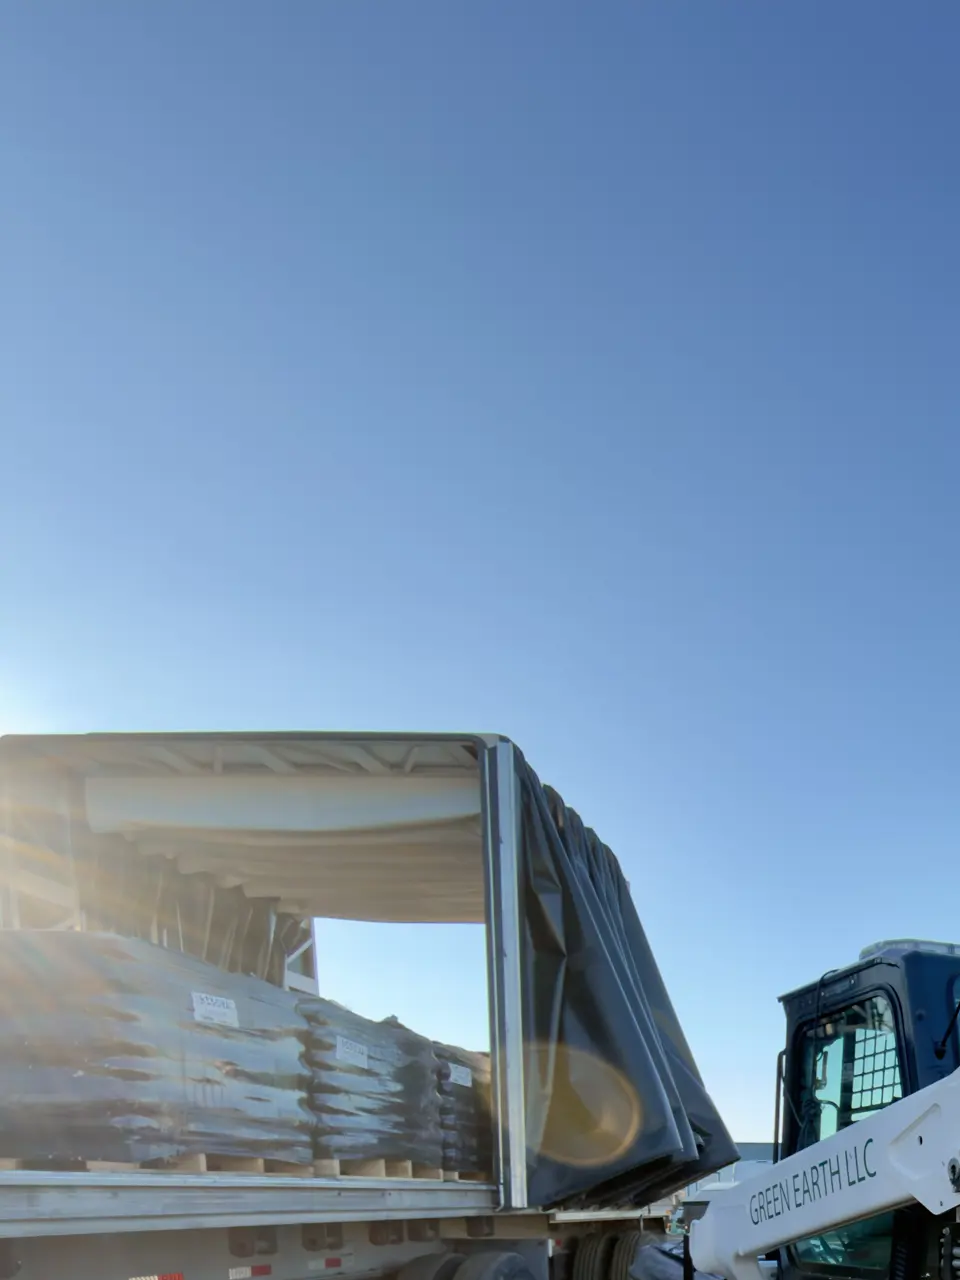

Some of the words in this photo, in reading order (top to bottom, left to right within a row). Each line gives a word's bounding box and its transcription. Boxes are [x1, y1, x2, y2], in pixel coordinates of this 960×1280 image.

[749, 1178, 791, 1226] GREEN
[792, 1154, 842, 1209] EARTH
[844, 1137, 877, 1187] LLC
